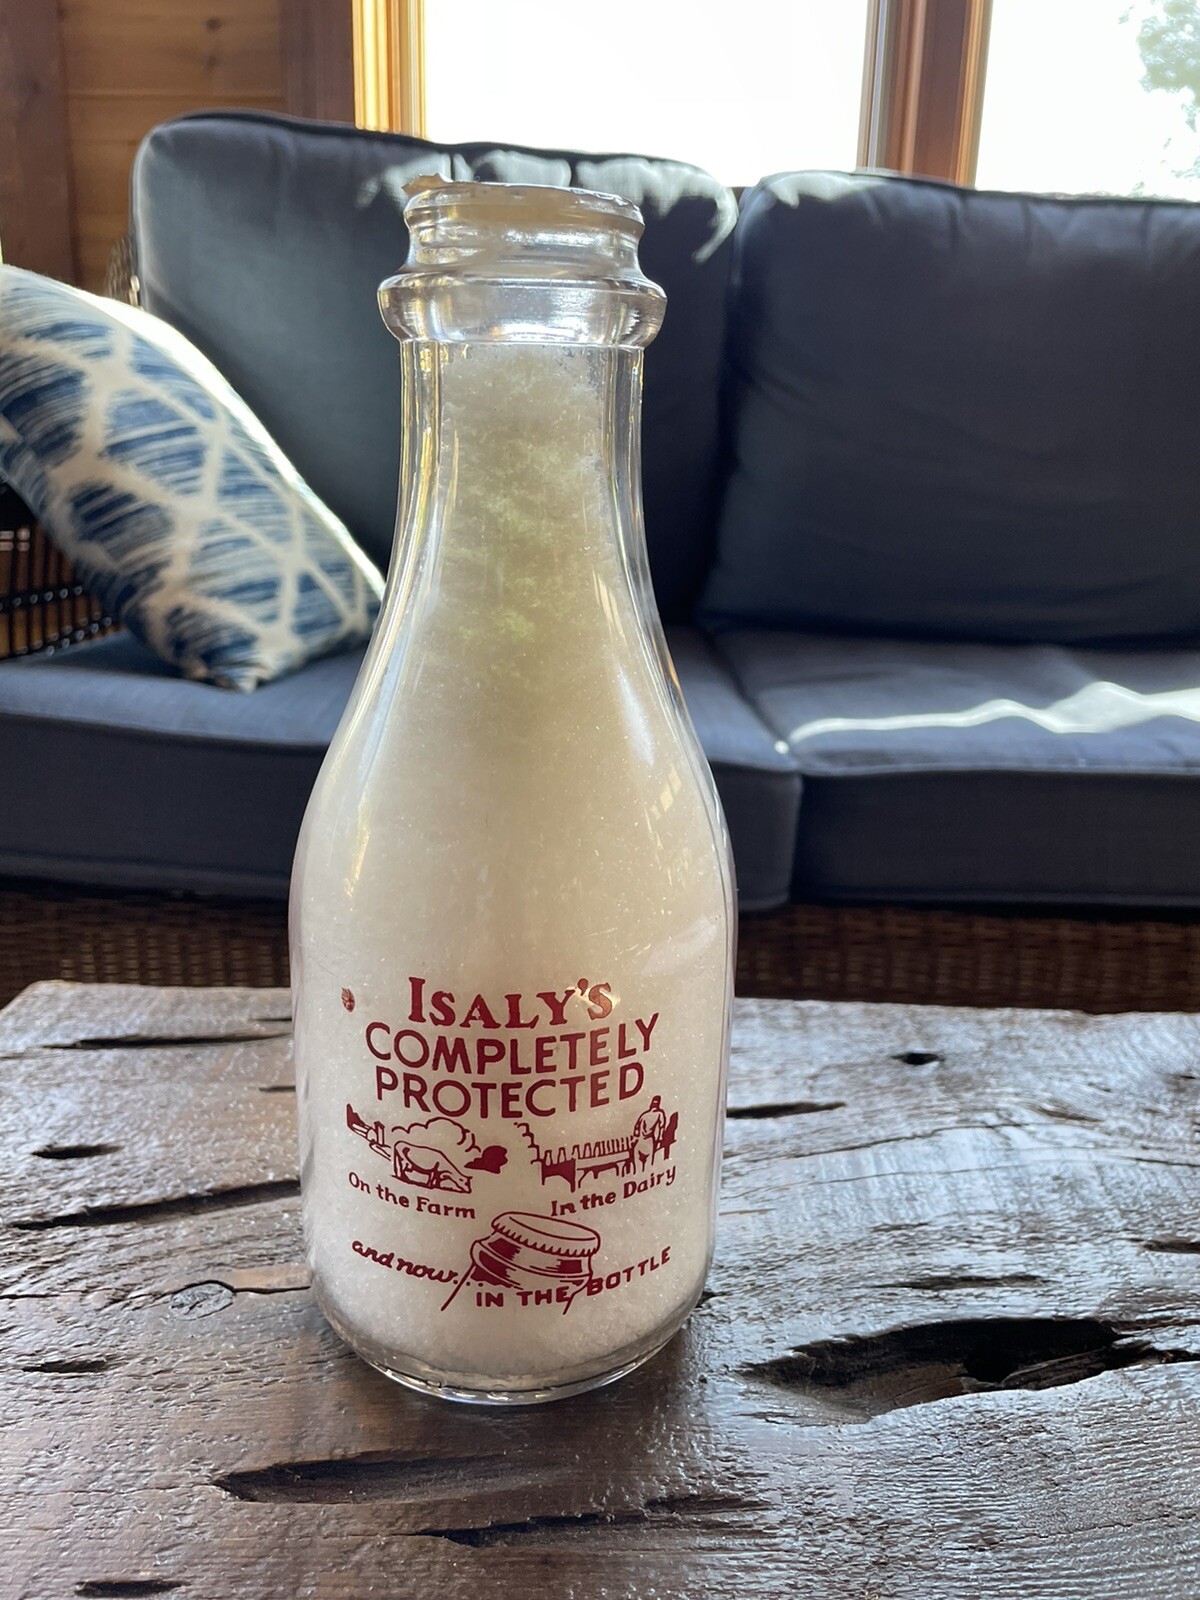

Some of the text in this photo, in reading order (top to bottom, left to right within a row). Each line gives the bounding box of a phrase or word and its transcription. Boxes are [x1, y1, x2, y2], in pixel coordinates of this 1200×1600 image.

[408, 976, 613, 1029] ISALY'S
[365, 1013, 659, 1075] COMPLETELY
[376, 1062, 644, 1118] PROTECTED
[349, 1172, 476, 1219] On the Farm
[551, 1166, 676, 1217] In the Dairy
[352, 1240, 392, 1268] and
[475, 1291, 504, 1307] IN
[516, 1286, 570, 1307] THE
[586, 1246, 672, 1296] BOTTLE
